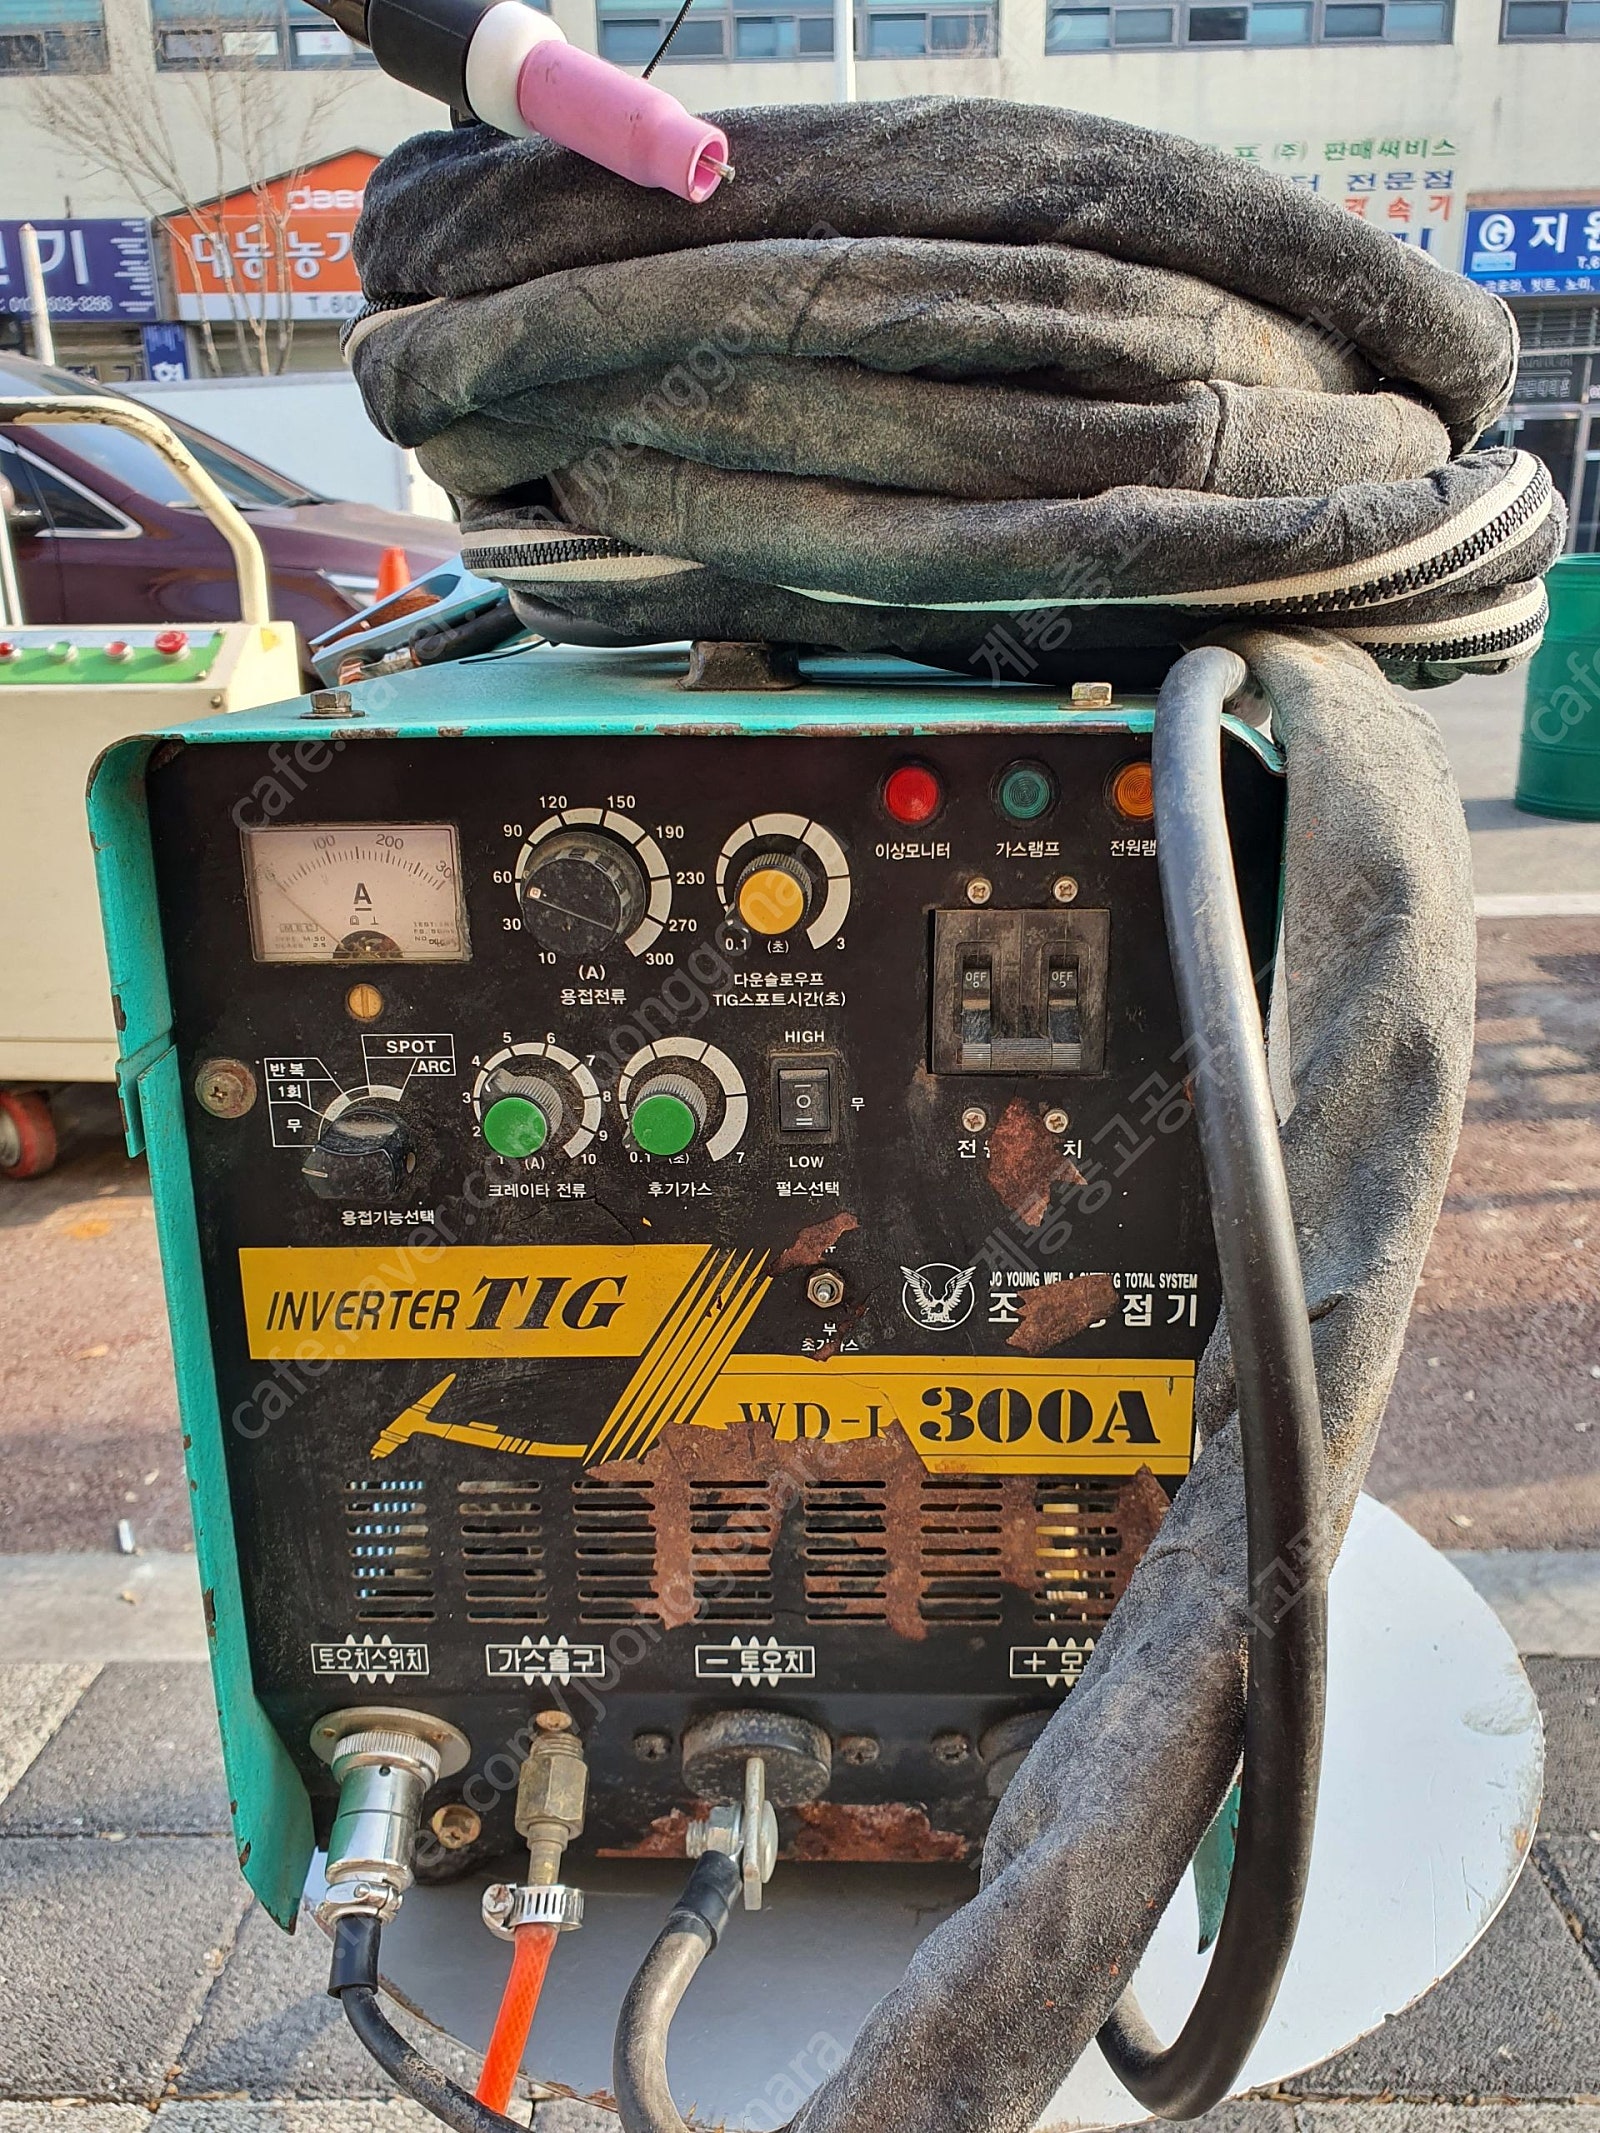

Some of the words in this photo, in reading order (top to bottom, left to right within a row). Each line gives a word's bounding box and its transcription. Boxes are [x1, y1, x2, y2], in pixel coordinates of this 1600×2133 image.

[539, 795, 567, 809] 120
[607, 795, 636, 809] 150
[503, 824, 523, 838] 90
[656, 825, 684, 840] 190
[312, 834, 336, 851] 100
[375, 833, 405, 851] 200
[995, 840, 1060, 859] 가스램프
[874, 841, 951, 860] 이상모니터
[492, 871, 513, 885] 60
[676, 871, 706, 885] 230
[353, 882, 373, 905] A
[502, 918, 522, 932] 30
[669, 918, 698, 933] 270
[725, 937, 748, 952] 0.1
[836, 937, 846, 951] 3
[538, 952, 556, 965] 10
[645, 952, 674, 966] 300
[578, 964, 606, 982] (A)
[733, 972, 825, 988] 다운슬로우프
[965, 971, 987, 983] OFF
[1050, 970, 1074, 983] OFF
[559, 987, 628, 1007] 용접전류
[502, 1031, 512, 1044] 5
[546, 1031, 556, 1045] 6
[784, 1030, 826, 1043] HIGH
[386, 1039, 437, 1053] SPOT
[417, 1060, 451, 1073] ARC
[471, 1055, 481, 1067] 4
[586, 1054, 596, 1066] 7
[277, 1084, 302, 1098] 1회
[462, 1092, 472, 1104] 3
[602, 1090, 612, 1103] 8
[286, 1118, 303, 1133] 무
[472, 1125, 482, 1138] 2
[599, 1130, 608, 1142] 9
[524, 1156, 546, 1171] (A)
[580, 1152, 597, 1165] 10
[736, 1151, 745, 1165] 7
[788, 1155, 825, 1169] LOW
[487, 1182, 550, 1199] 크레이타
[556, 1182, 588, 1199] 전류
[646, 1181, 713, 1198] 후기가스
[775, 1180, 841, 1198] 펄스선택
[340, 1209, 436, 1226] 용접기능선택
[989, 1271, 1003, 1287] JO
[1006, 1271, 1040, 1288] YOUNG
[1124, 1272, 1156, 1289] TOTAL
[1158, 1273, 1199, 1290] SYSTEM
[265, 1290, 461, 1332] INVERTER
[465, 1275, 629, 1332] TIG
[918, 1386, 1162, 1446] 300A
[318, 1646, 424, 1673] 토오치스위치
[497, 1648, 598, 1674] 가스출구
[739, 1649, 806, 1675] 토오치
